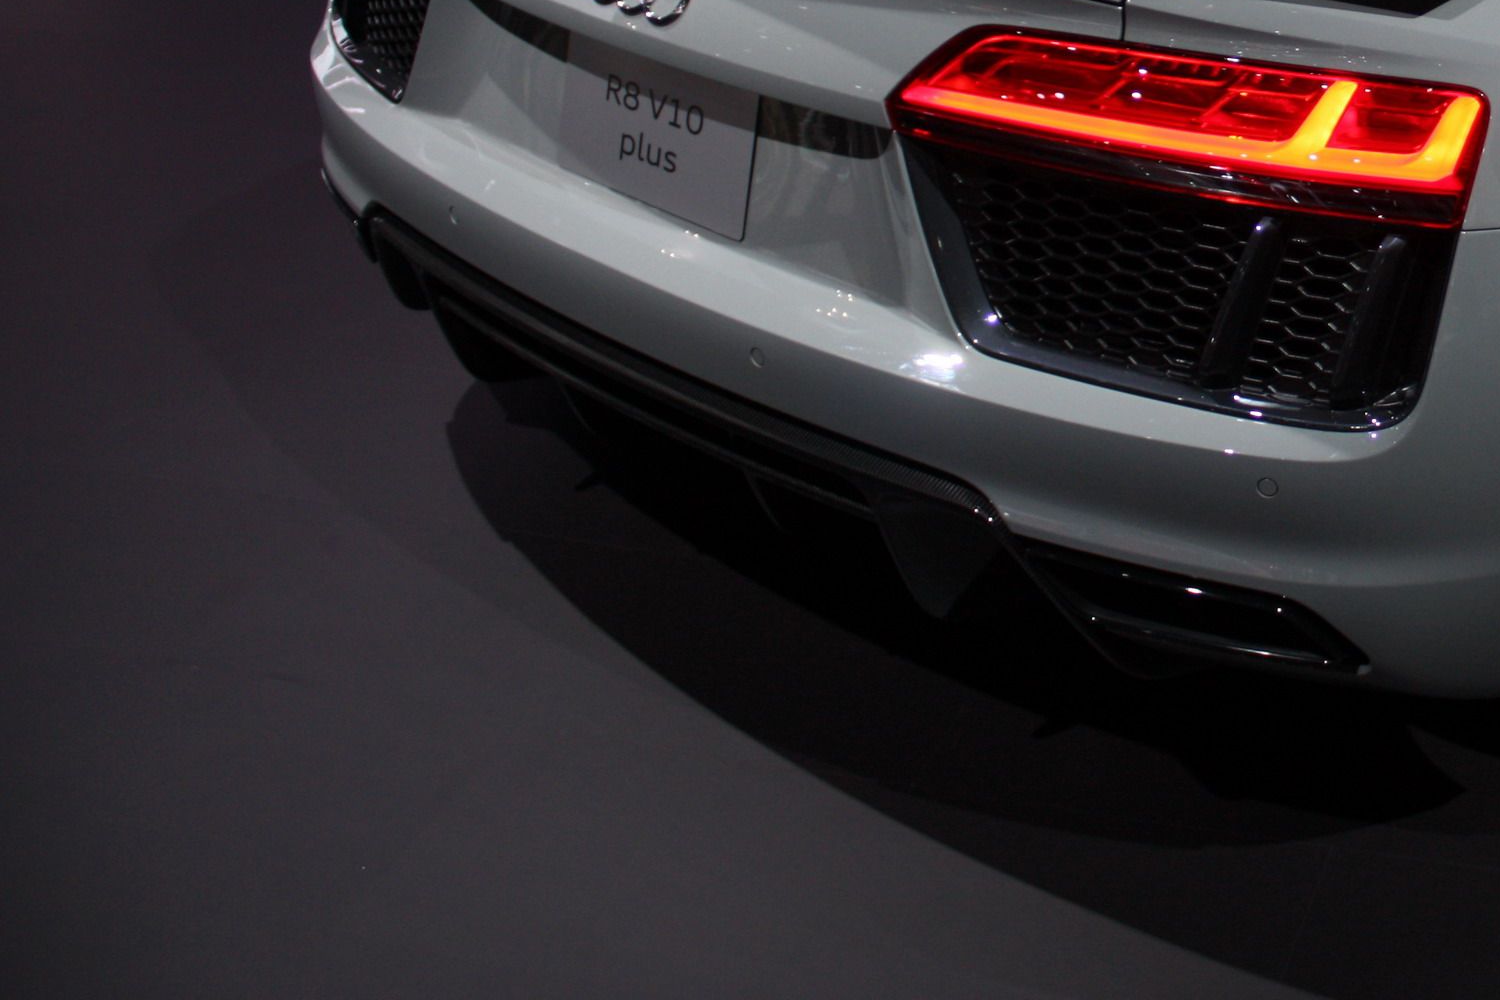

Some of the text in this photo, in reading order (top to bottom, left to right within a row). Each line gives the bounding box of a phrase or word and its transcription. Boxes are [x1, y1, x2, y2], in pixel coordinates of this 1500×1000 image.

[606, 73, 704, 135] R8 V10
[619, 132, 677, 173] plus
